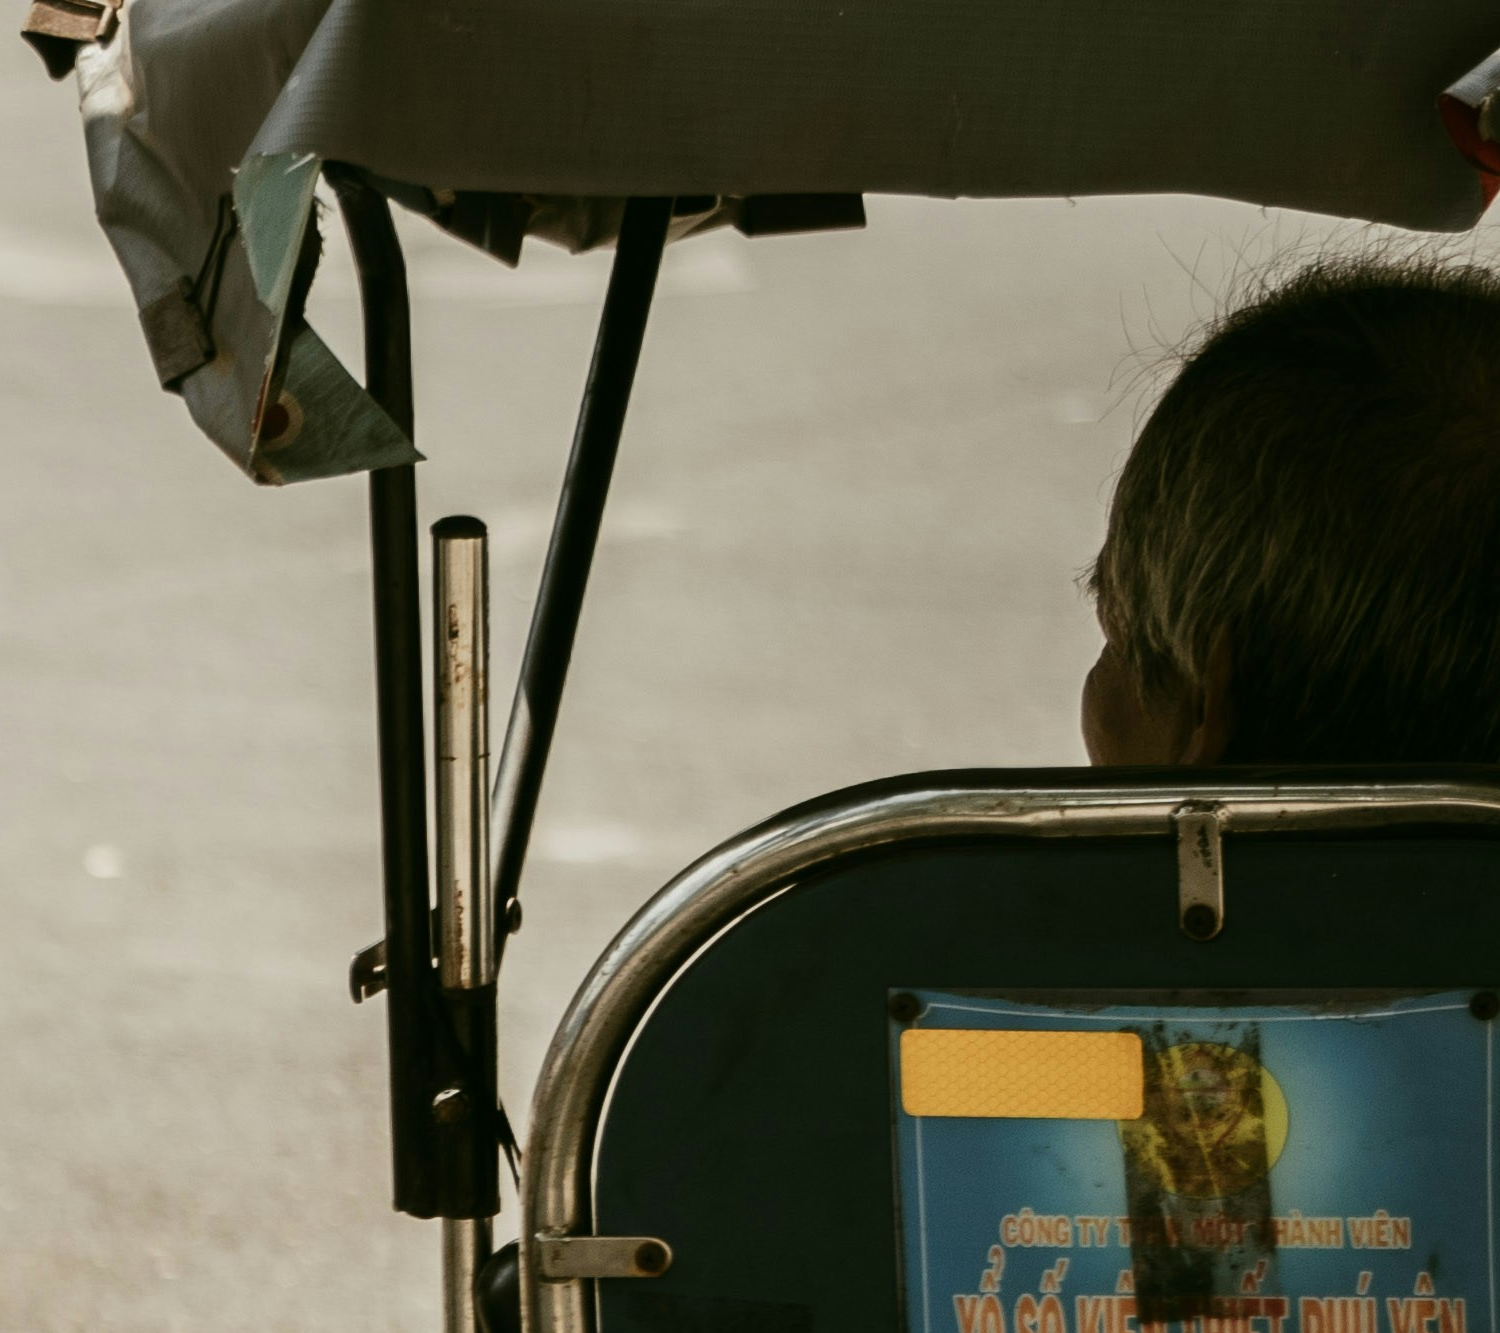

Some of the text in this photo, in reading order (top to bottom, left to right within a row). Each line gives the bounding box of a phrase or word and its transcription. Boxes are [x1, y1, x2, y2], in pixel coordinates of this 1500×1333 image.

[1001, 1208, 1071, 1248] CÔNG
[1076, 1216, 1109, 1248] TY
[1258, 1209, 1344, 1248] HÀNH
[1347, 1209, 1411, 1249] VIÊN
